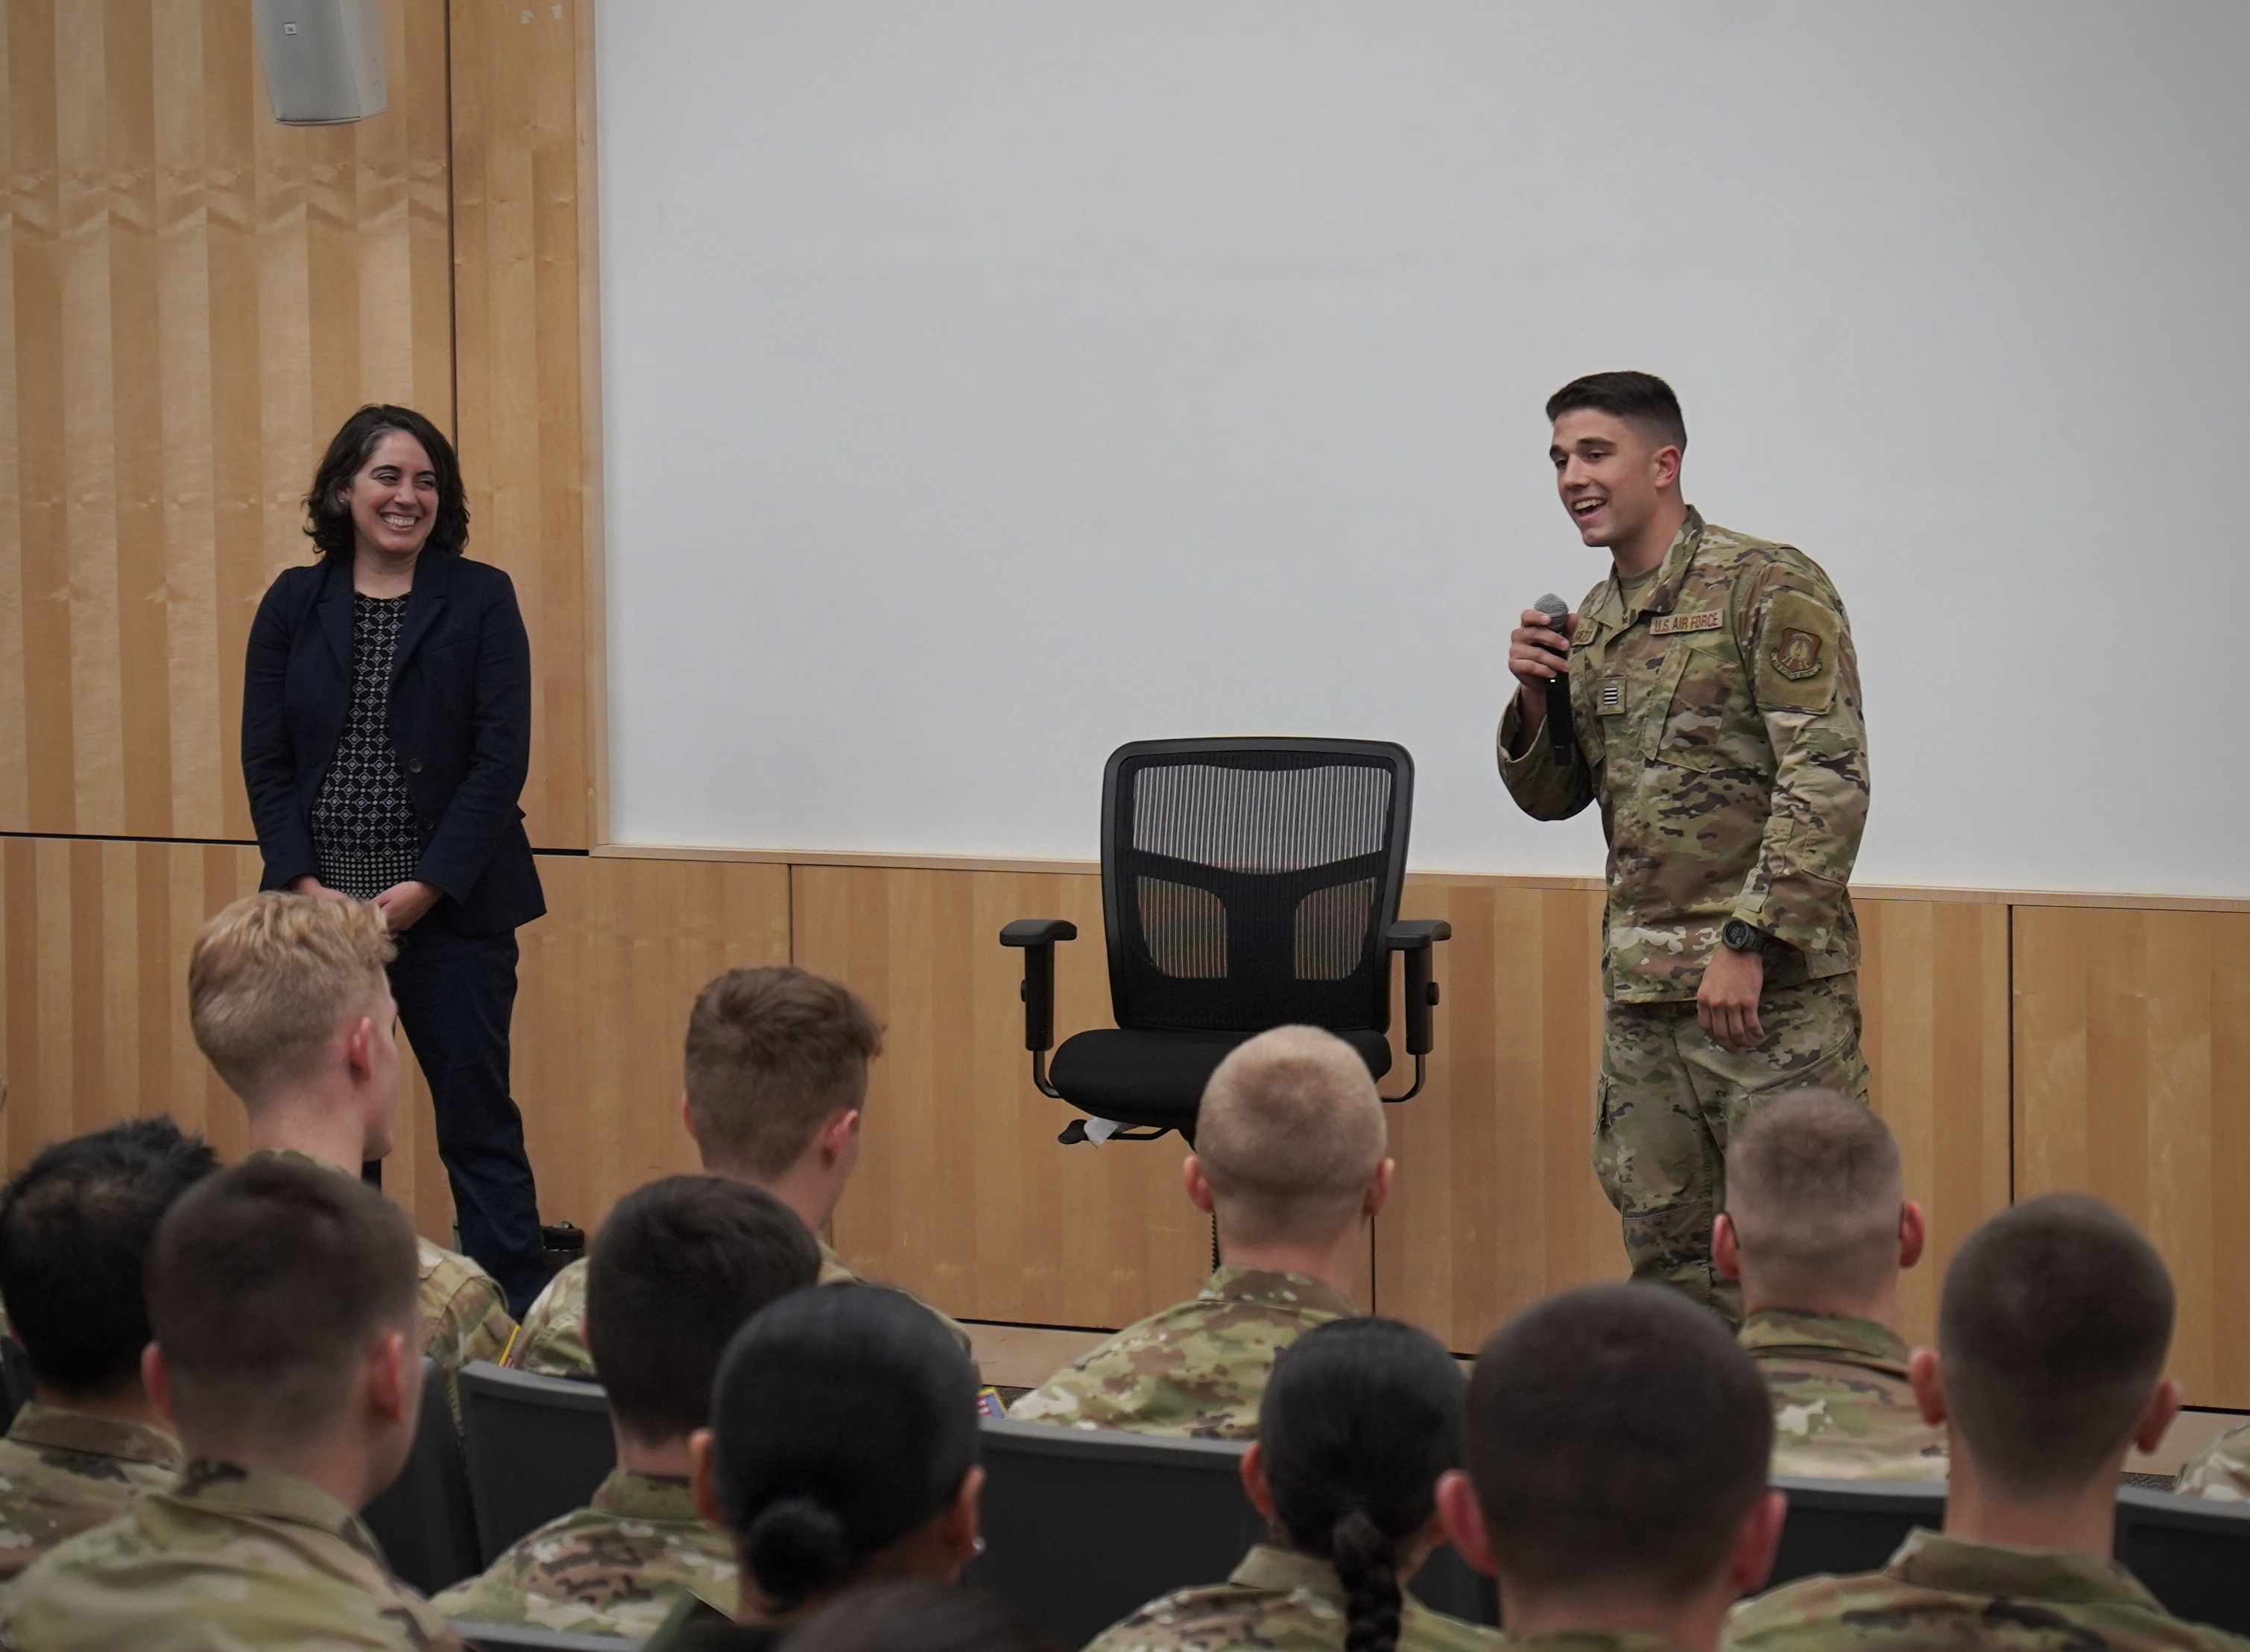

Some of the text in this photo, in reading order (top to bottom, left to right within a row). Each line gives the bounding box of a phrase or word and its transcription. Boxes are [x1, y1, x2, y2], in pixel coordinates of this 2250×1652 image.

[1655, 613, 1718, 633] U.S. AIR FORCE
